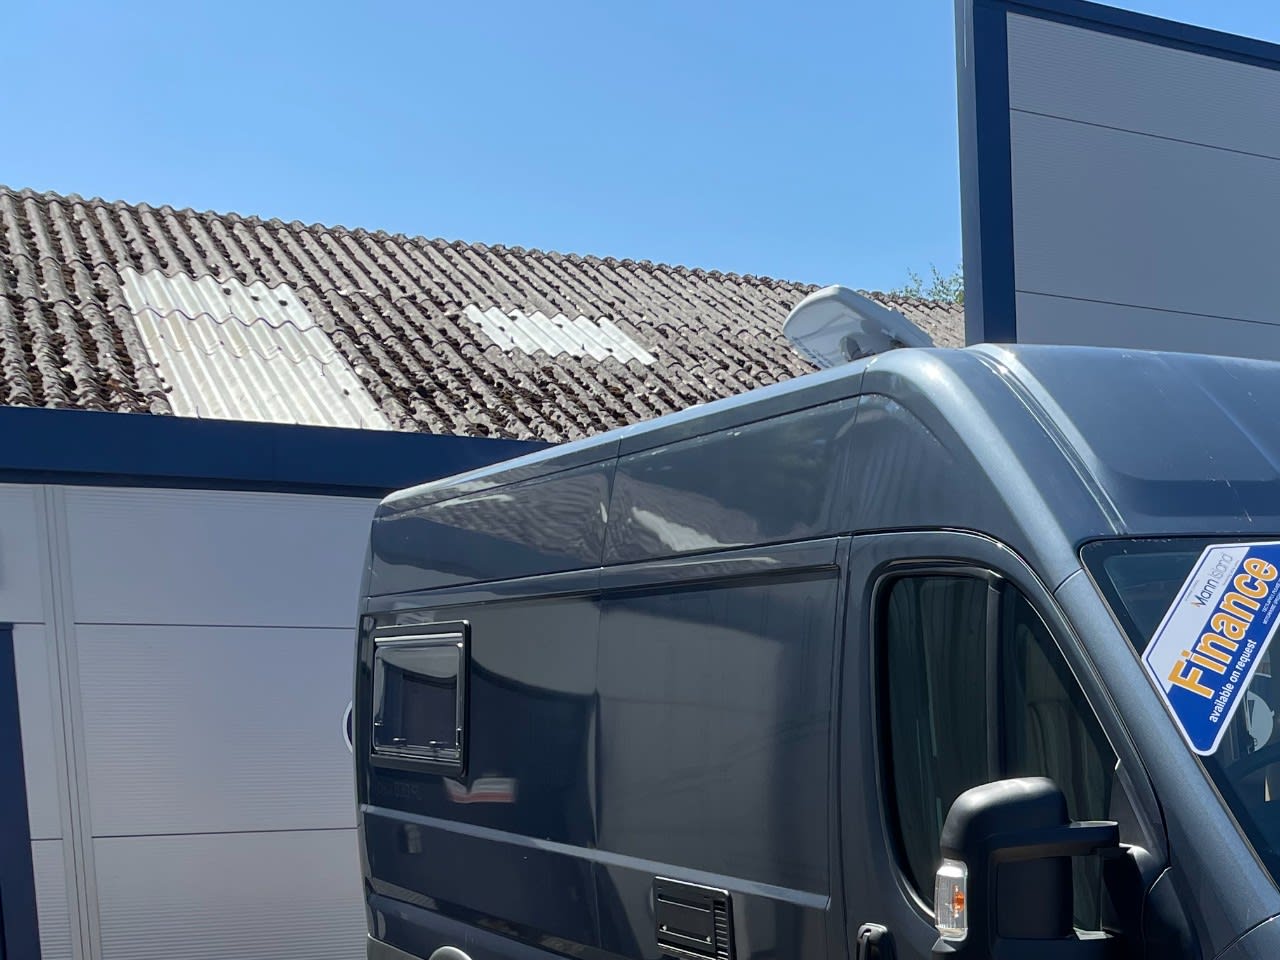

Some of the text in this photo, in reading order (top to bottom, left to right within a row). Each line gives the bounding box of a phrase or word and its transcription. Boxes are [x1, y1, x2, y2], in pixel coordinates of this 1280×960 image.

[1168, 557, 1278, 699] Finance
[1192, 578, 1217, 607] Mann
[1209, 639, 1257, 723] available on request
